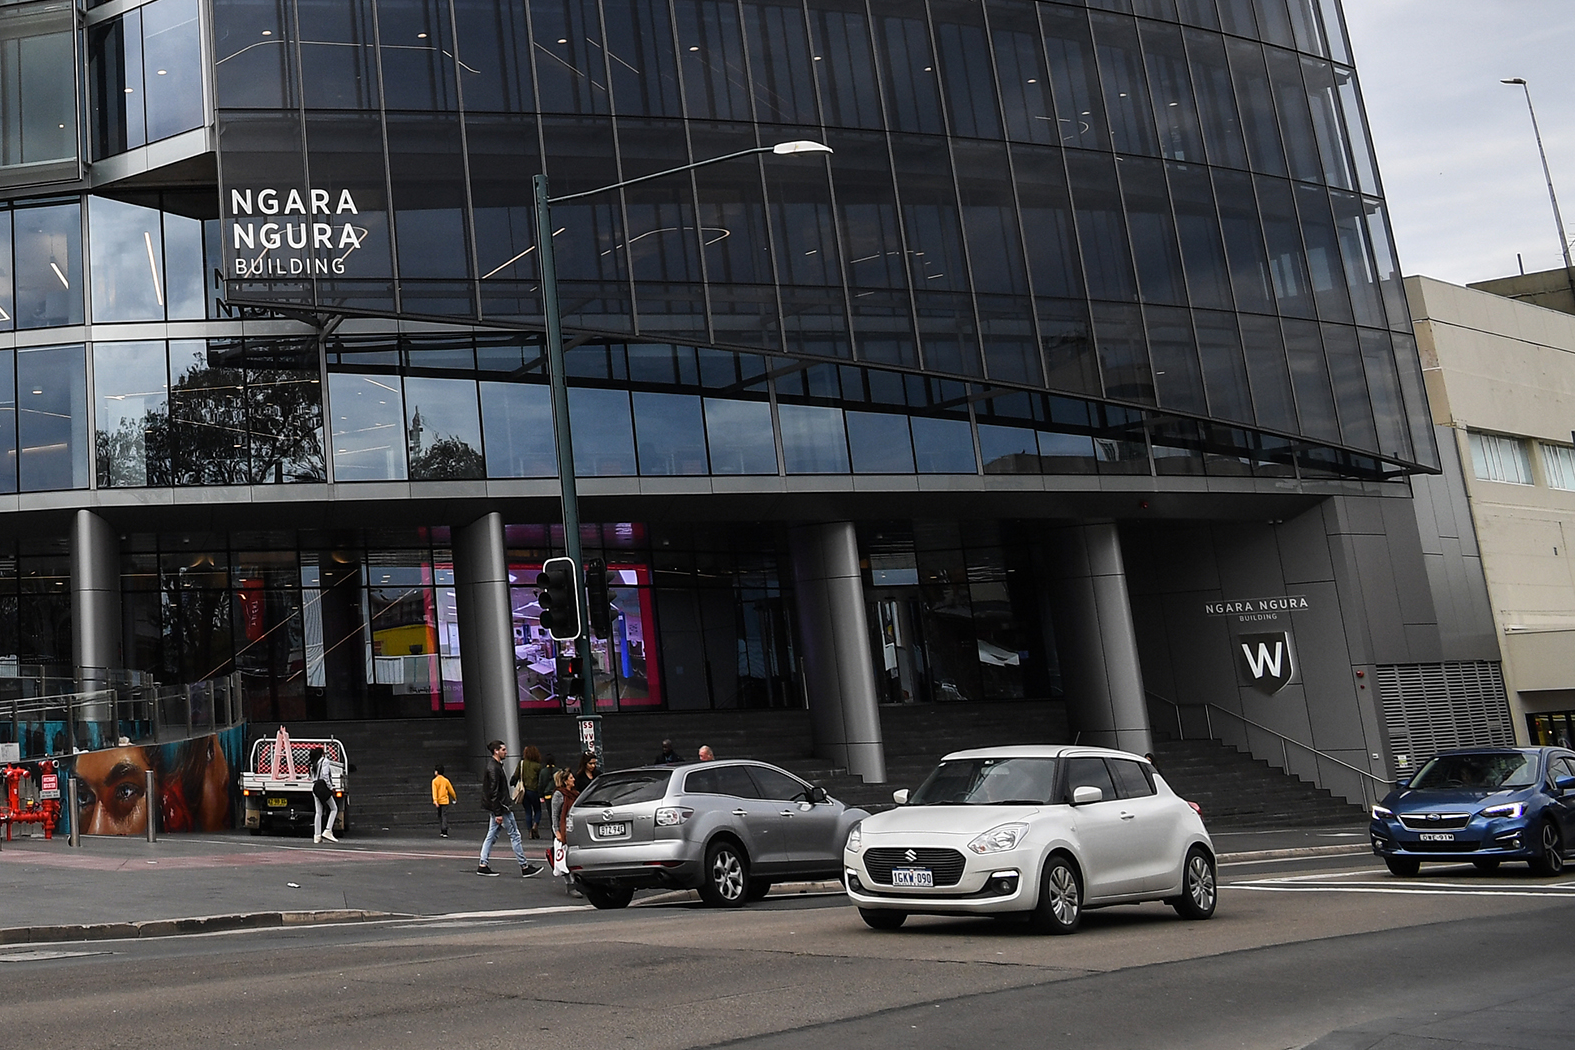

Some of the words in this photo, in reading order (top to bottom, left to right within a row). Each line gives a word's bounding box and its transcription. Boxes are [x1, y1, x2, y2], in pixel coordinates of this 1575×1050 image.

[231, 188, 359, 215] NGARA
[233, 223, 361, 249] NGURA
[235, 258, 346, 275] BUILDING
[1205, 602, 1254, 614] NGARA
[1259, 598, 1309, 610] NGURA
[1239, 613, 1278, 622] BUILDING
[1241, 641, 1282, 679] W
